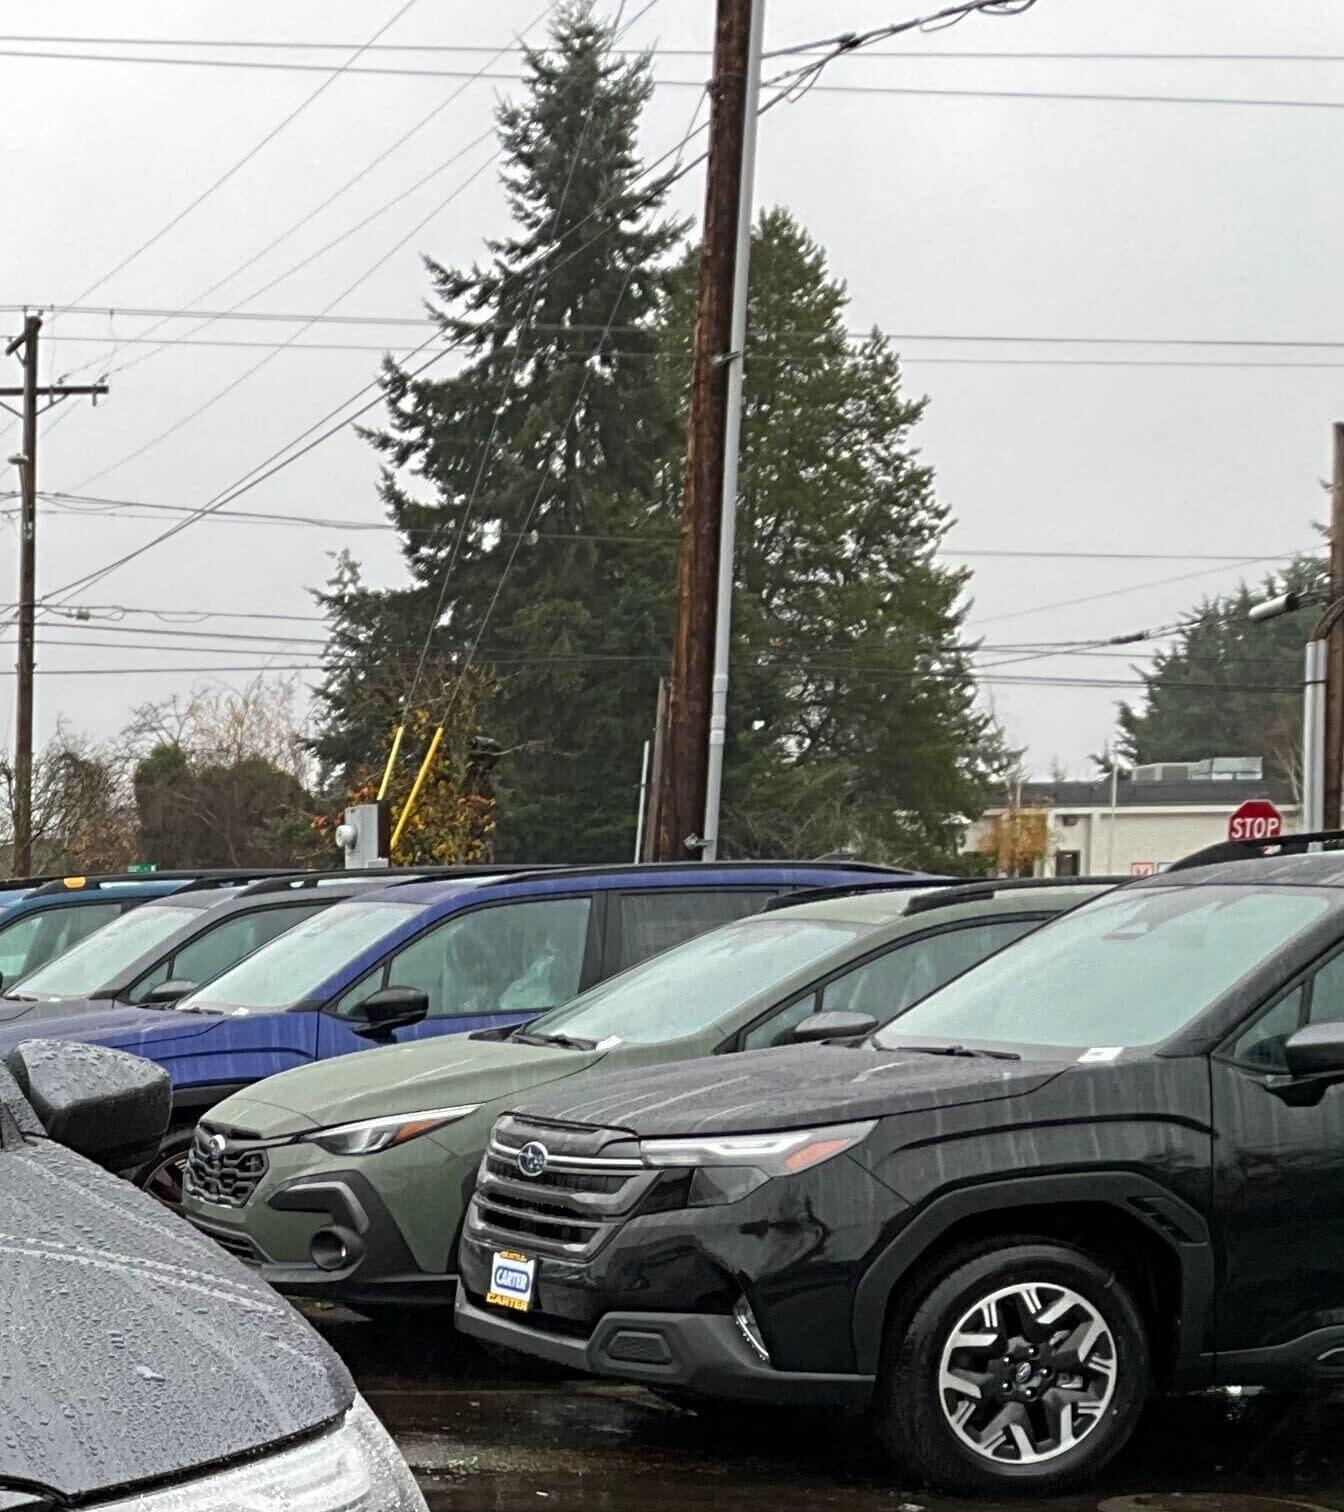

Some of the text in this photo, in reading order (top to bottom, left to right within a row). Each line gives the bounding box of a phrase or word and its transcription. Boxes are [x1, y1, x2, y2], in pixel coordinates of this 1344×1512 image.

[1231, 817, 1279, 837] STOP
[496, 1268, 528, 1290] CARTER
[486, 1292, 528, 1311] CARTER
